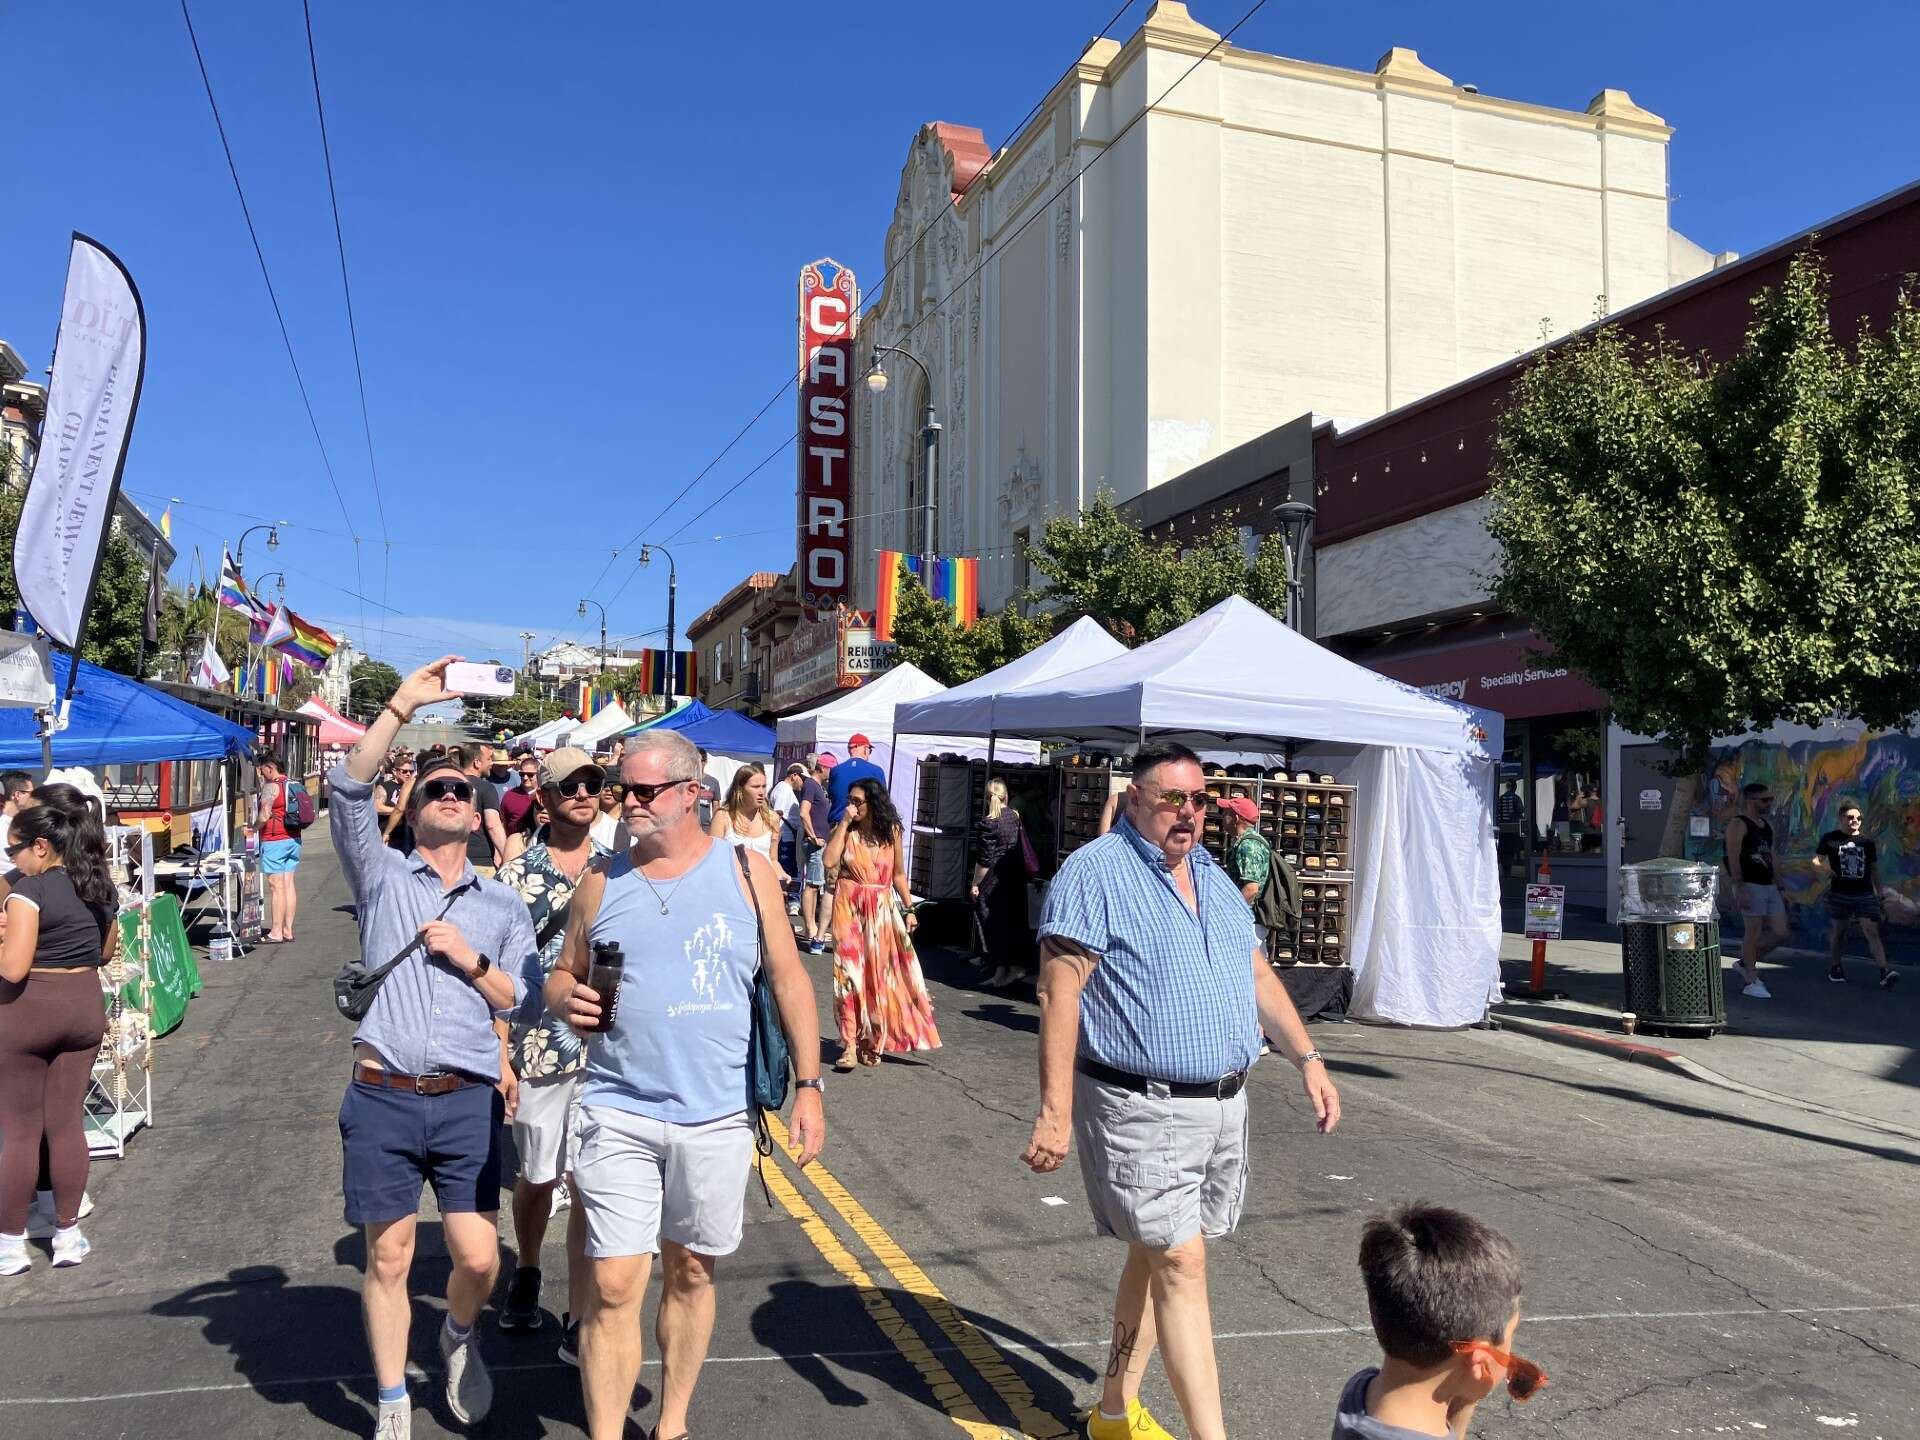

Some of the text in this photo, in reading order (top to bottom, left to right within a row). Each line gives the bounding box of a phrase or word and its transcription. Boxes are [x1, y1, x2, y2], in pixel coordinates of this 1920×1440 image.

[80, 364, 117, 497] PERMANENT
[809, 296, 847, 588] CASTRO
[848, 658, 890, 669] CASTRO
[1480, 671, 1524, 689] Specialty
